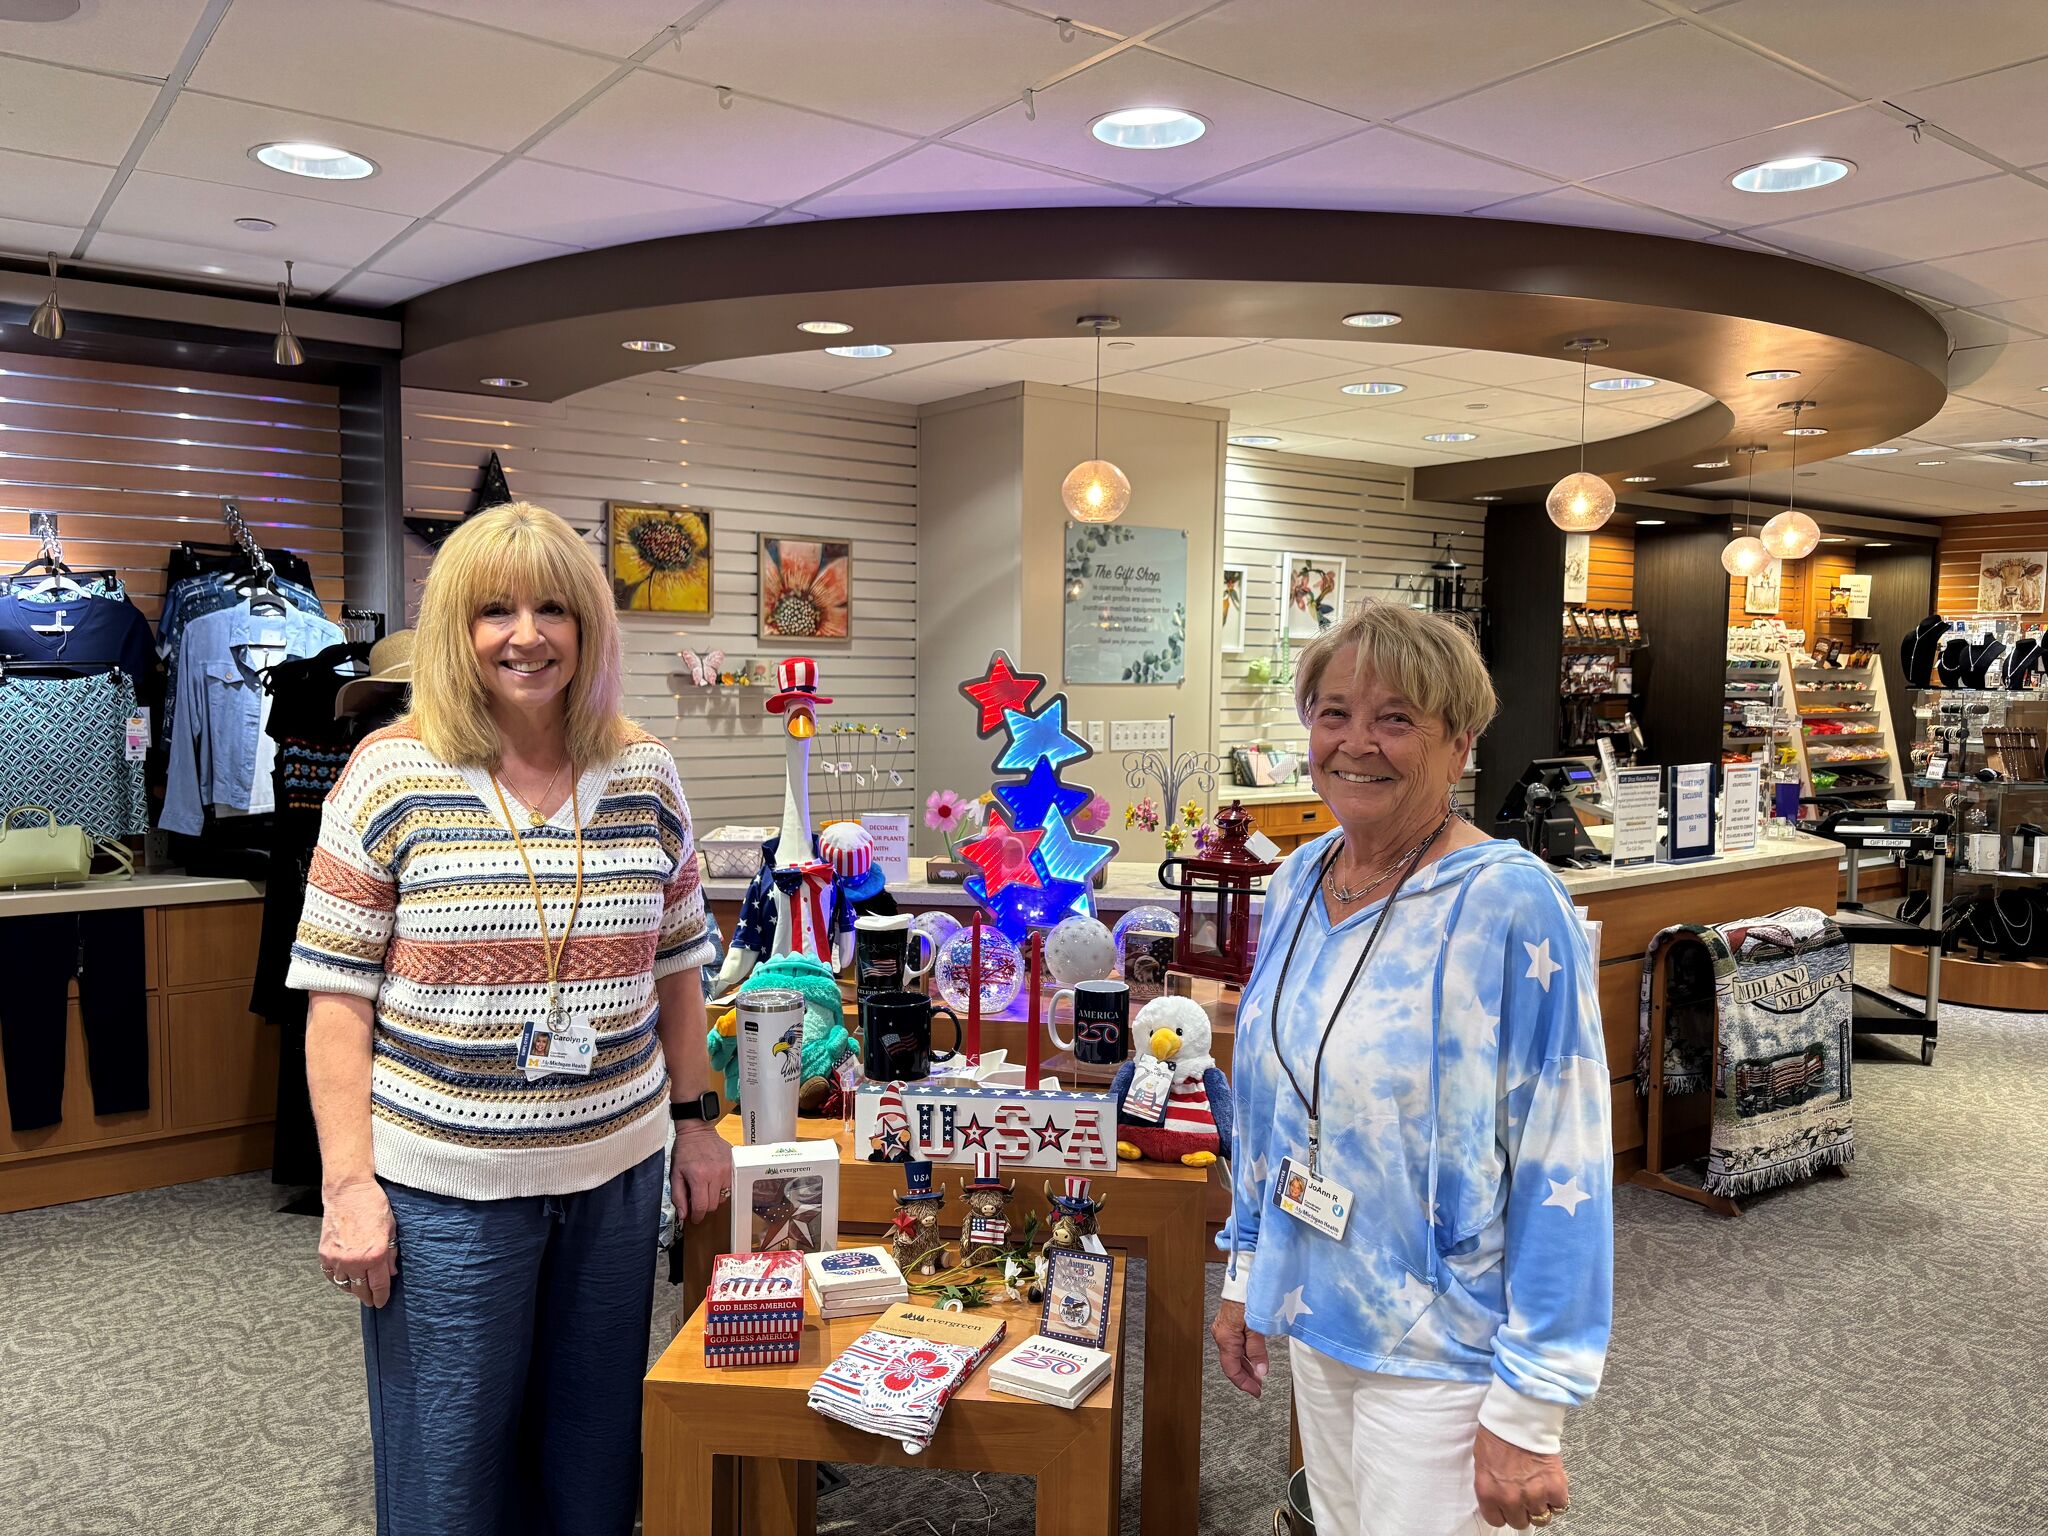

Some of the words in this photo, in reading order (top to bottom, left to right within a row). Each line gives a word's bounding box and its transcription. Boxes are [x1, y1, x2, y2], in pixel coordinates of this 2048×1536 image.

[1094, 564, 1113, 579] The
[1114, 565, 1135, 586] Gift
[1135, 566, 1161, 586] Shop
[1739, 968, 1805, 1002] MIDLAND
[1078, 1009, 1120, 1020] AMERICA
[553, 1033, 581, 1044] Carolyn
[1077, 1021, 1120, 1044] 250
[528, 1058, 540, 1067] M
[571, 1061, 587, 1069] Health
[779, 1166, 812, 1174] evergreen
[913, 1174, 930, 1182] USA
[1308, 1182, 1331, 1199] JoAnn
[1332, 1194, 1339, 1202] R
[1323, 1220, 1340, 1233] Health
[713, 1304, 732, 1312] GOD
[733, 1303, 758, 1311] BLESS
[759, 1301, 797, 1310] AMERICA
[926, 1317, 983, 1331] evergreen
[756, 1332, 794, 1341] AMERICA
[1028, 1344, 1089, 1364] AMERICA
[1010, 1349, 1082, 1376] 250
